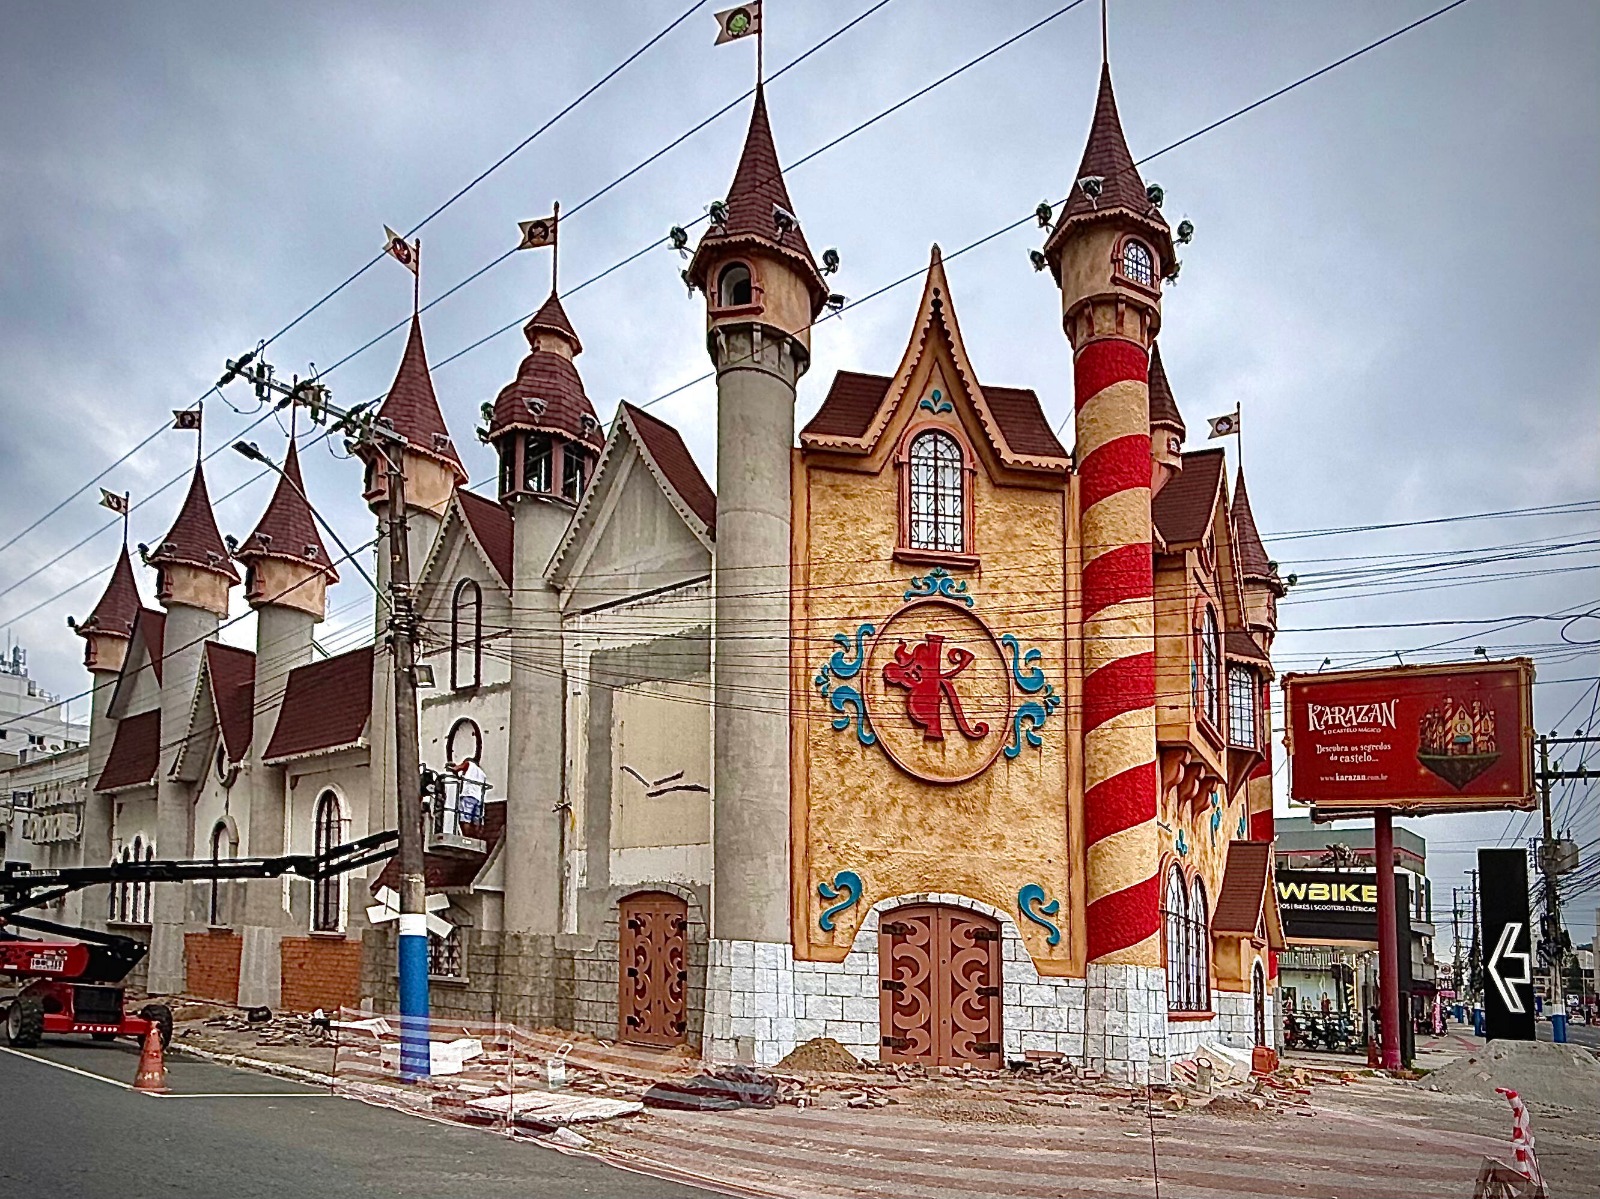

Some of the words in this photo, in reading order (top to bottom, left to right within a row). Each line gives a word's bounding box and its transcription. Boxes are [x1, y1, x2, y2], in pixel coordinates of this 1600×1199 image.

[1308, 699, 1399, 731] KARAZAN
[1316, 744, 1348, 754] Descubra
[1360, 742, 1391, 752] segredos
[1320, 773, 1388, 781] www.karazan.com.br
